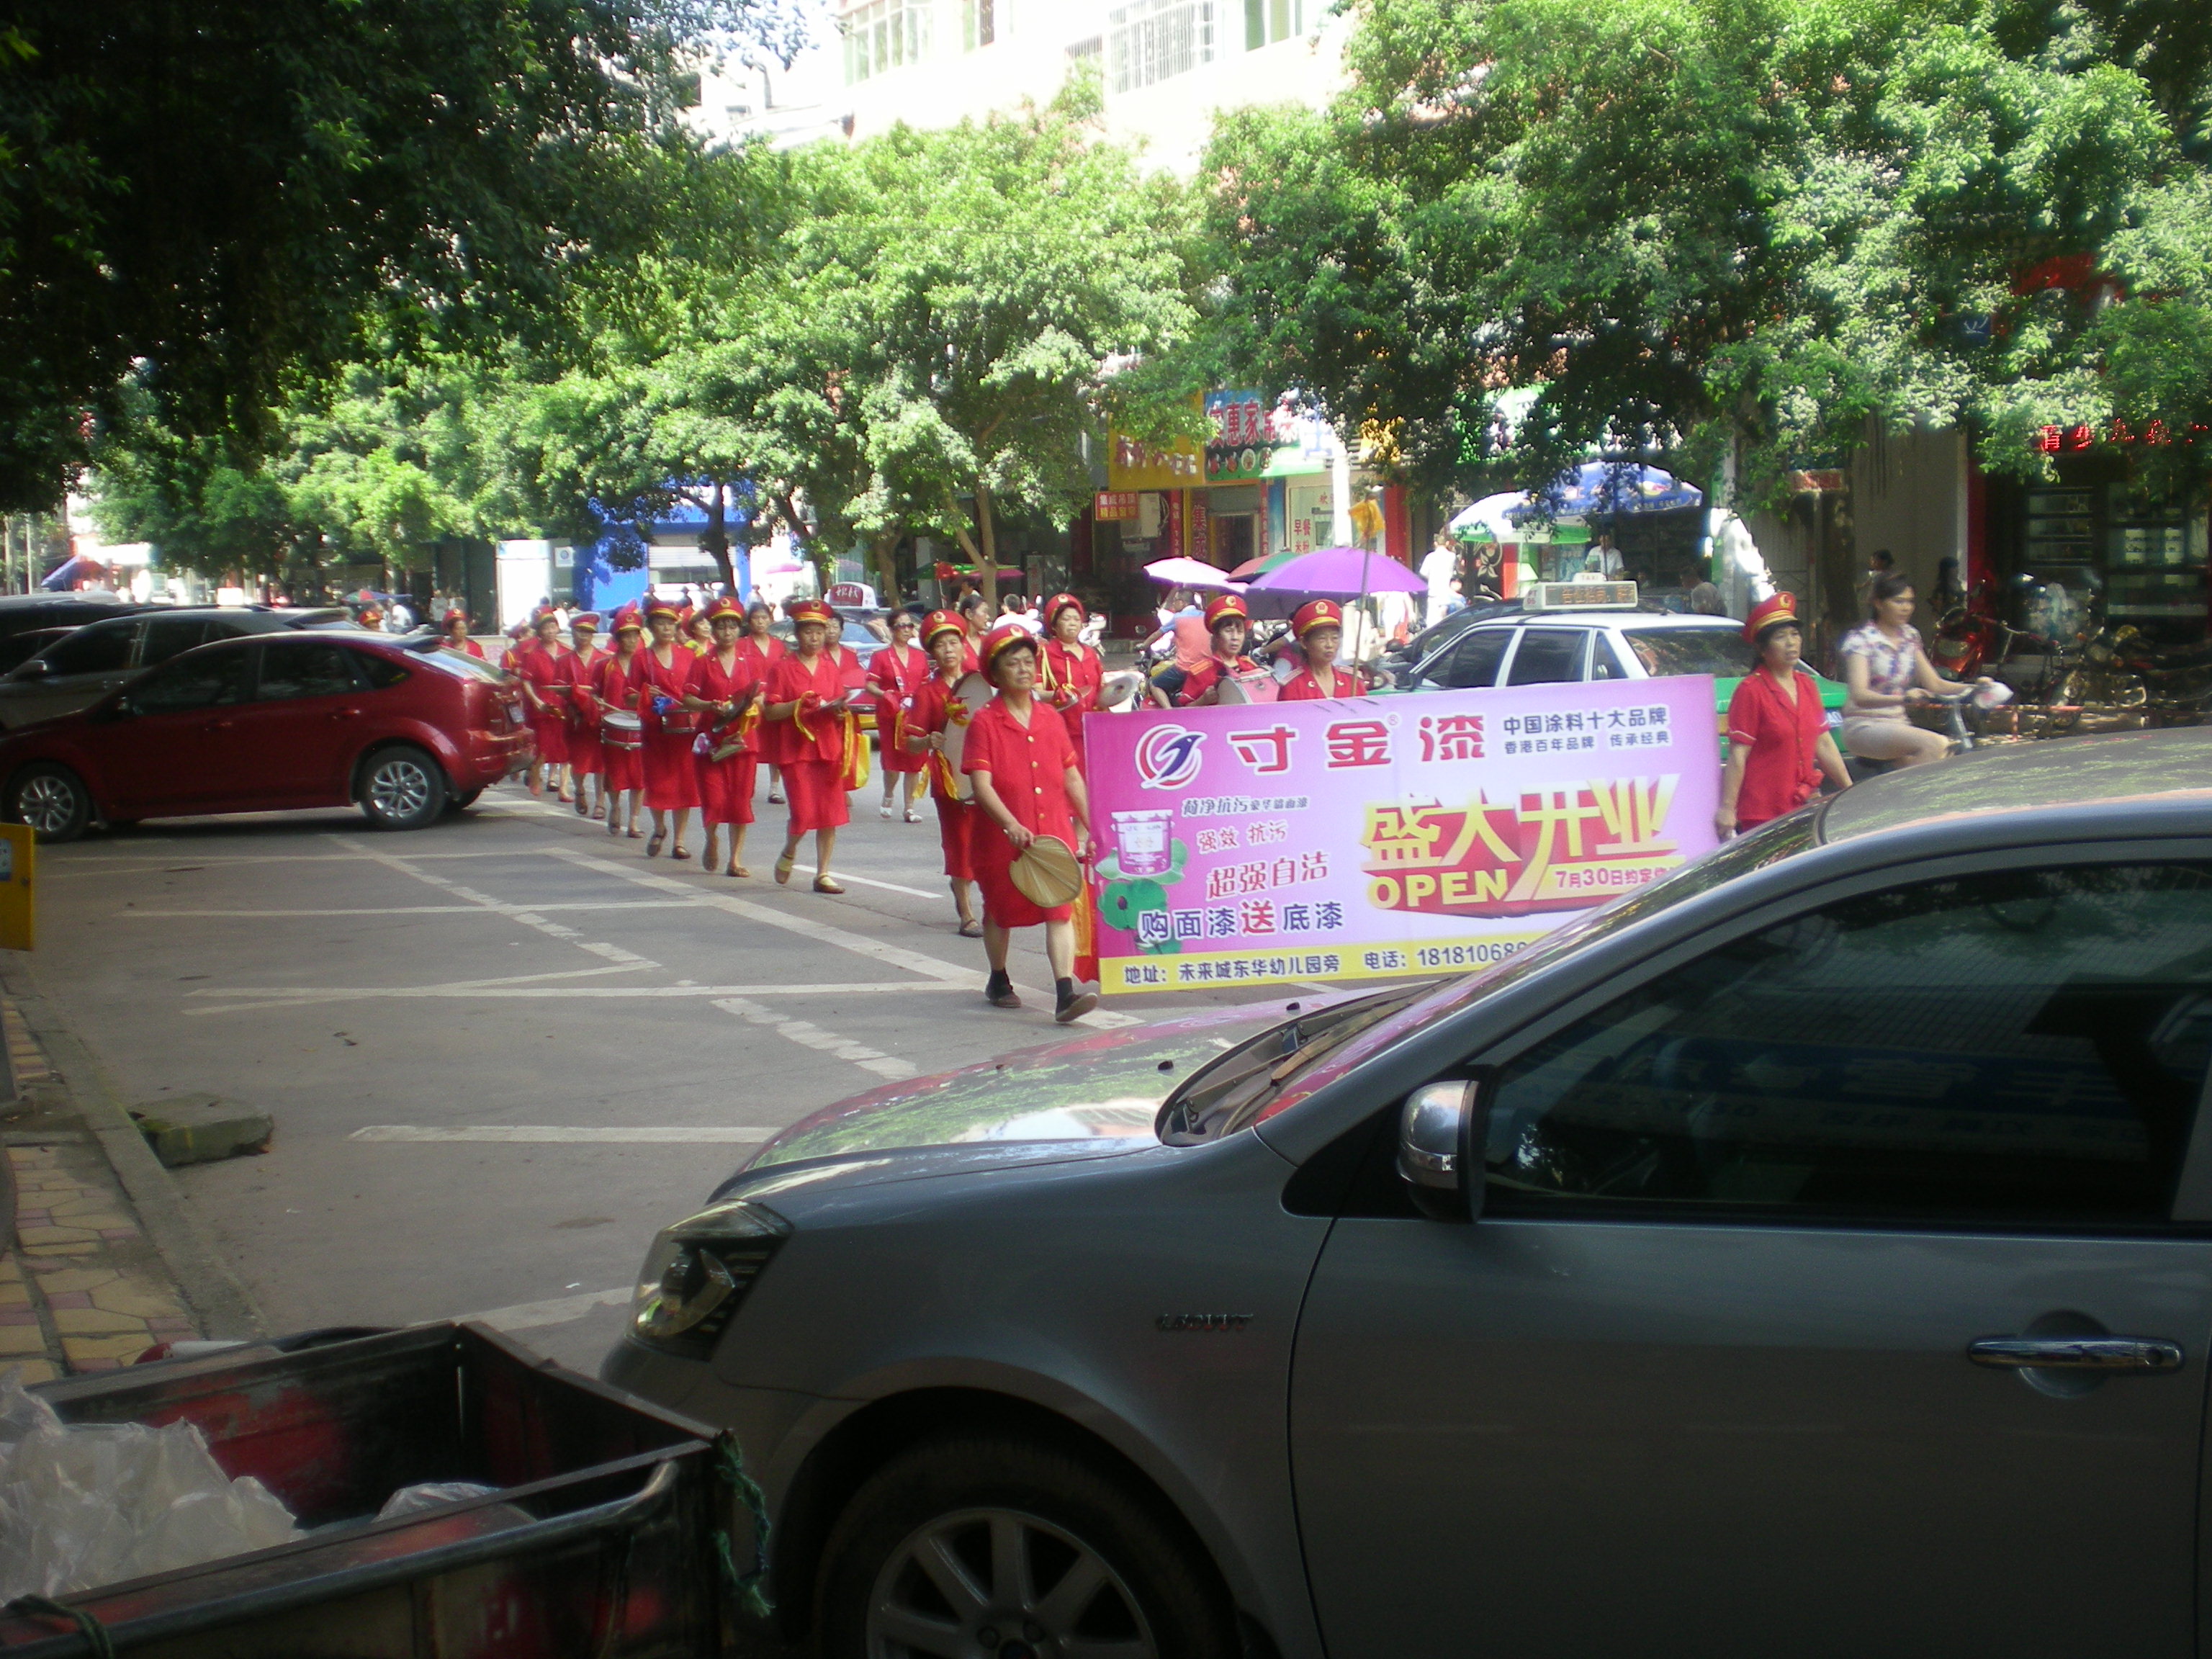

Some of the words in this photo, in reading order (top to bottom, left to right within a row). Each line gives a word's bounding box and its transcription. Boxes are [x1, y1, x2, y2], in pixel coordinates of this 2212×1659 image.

[1294, 518, 1310, 536] 早餐
[1504, 707, 1668, 735] 中国涂料十大品牌
[1504, 736, 1595, 755] 香港百年品牌
[1610, 731, 1669, 747] 传承经典
[1199, 828, 1238, 852] 强效
[1248, 821, 1287, 844] 抗污
[1359, 774, 1681, 899] 盛大开业
[1208, 850, 1328, 899] 超强自洁
[1367, 868, 1509, 909] OPEN
[1141, 900, 1344, 938] 购面漆送底漆
[1364, 950, 1407, 969] 电话：
[1417, 942, 1527, 966] 18181068
